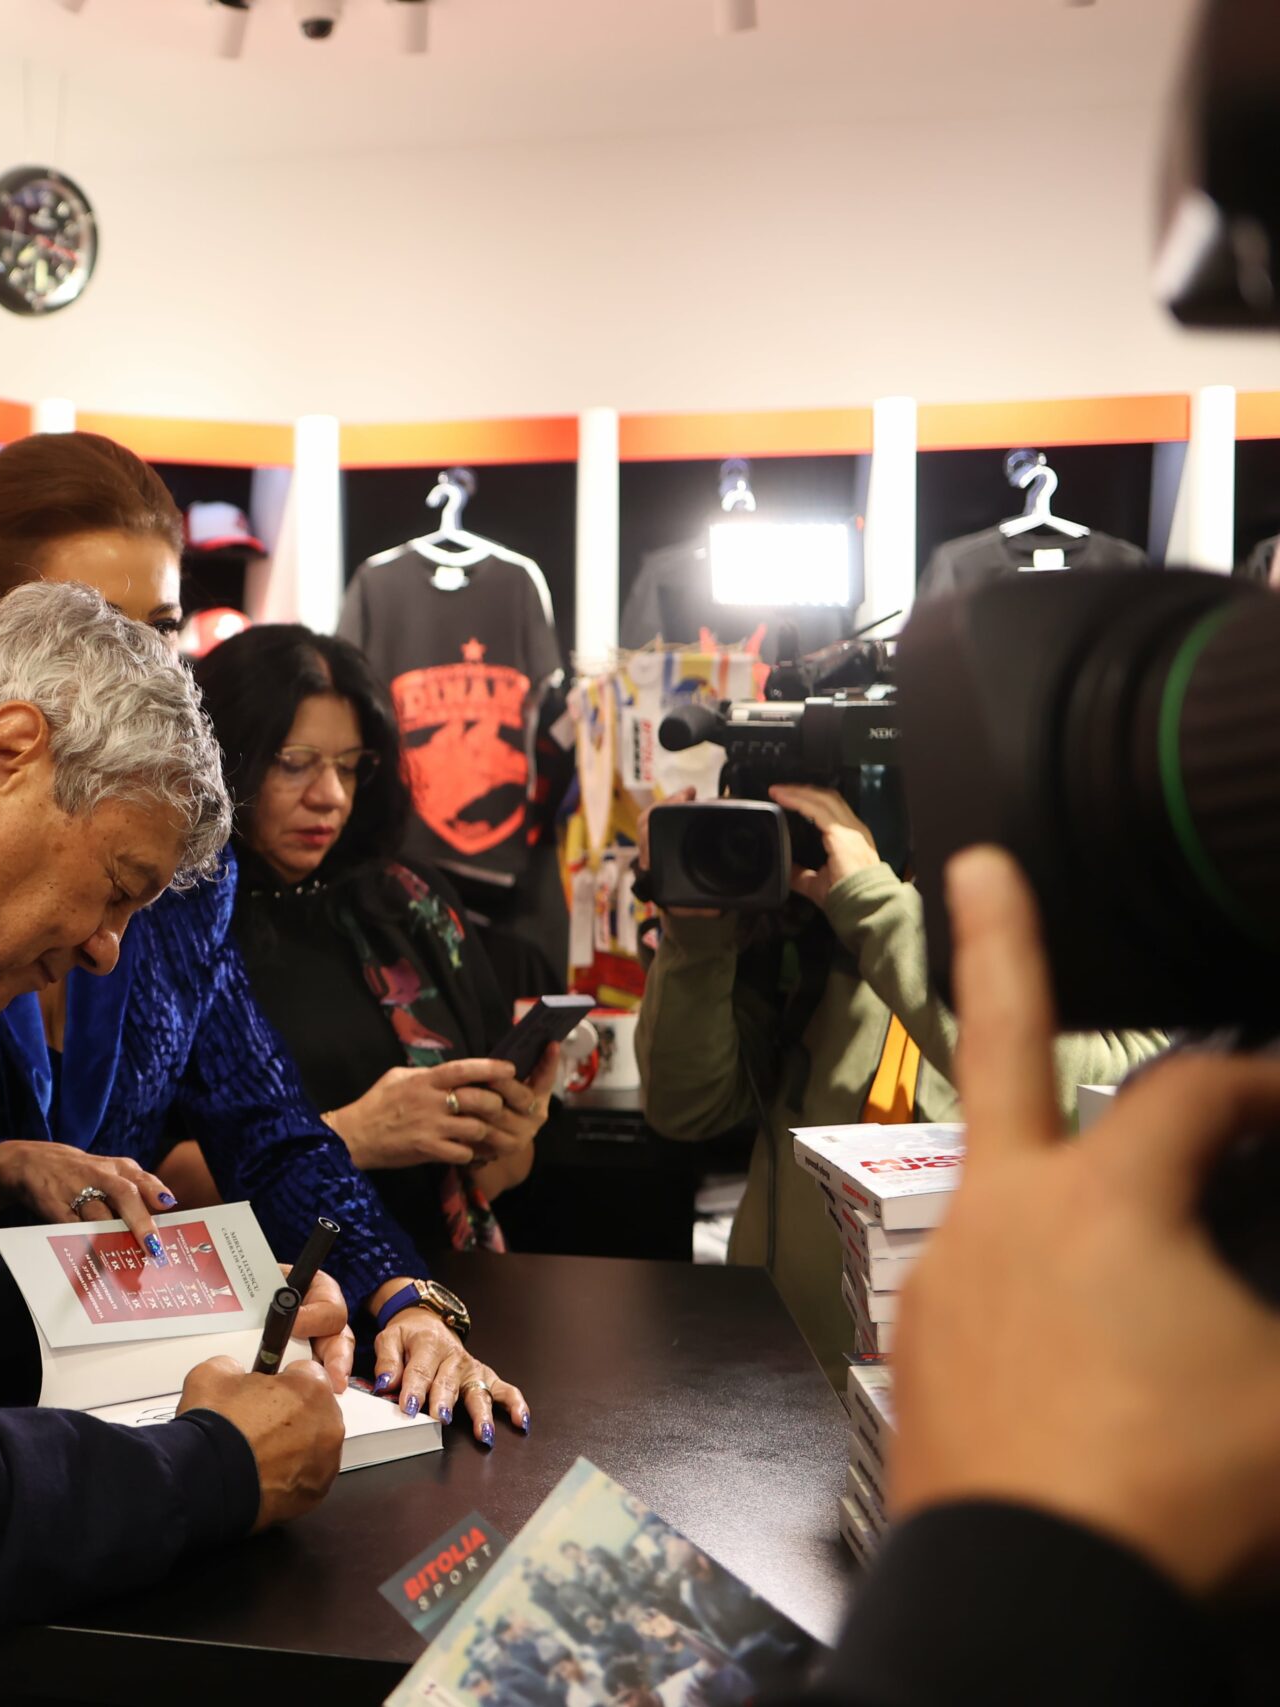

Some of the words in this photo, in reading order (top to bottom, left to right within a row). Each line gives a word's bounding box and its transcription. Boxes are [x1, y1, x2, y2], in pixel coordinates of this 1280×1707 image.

[860, 1155, 963, 1169] Mirc
[126, 1258, 137, 1269] 3X
[171, 1252, 182, 1264] 8X
[231, 1232, 246, 1259] MIRCEA
[243, 1260, 260, 1291] LUCESCU
[110, 1260, 121, 1270] 1X
[89, 1261, 101, 1278] ECHIPE
[99, 1279, 118, 1309] ANTRENATE
[238, 1265, 255, 1298] ANTRENOR
[131, 1298, 142, 1309] 1X
[147, 1298, 158, 1309] 7X
[192, 1293, 203, 1304] 9X
[403, 1526, 486, 1601] BITOLIA
[417, 1543, 491, 1612] SPORT
